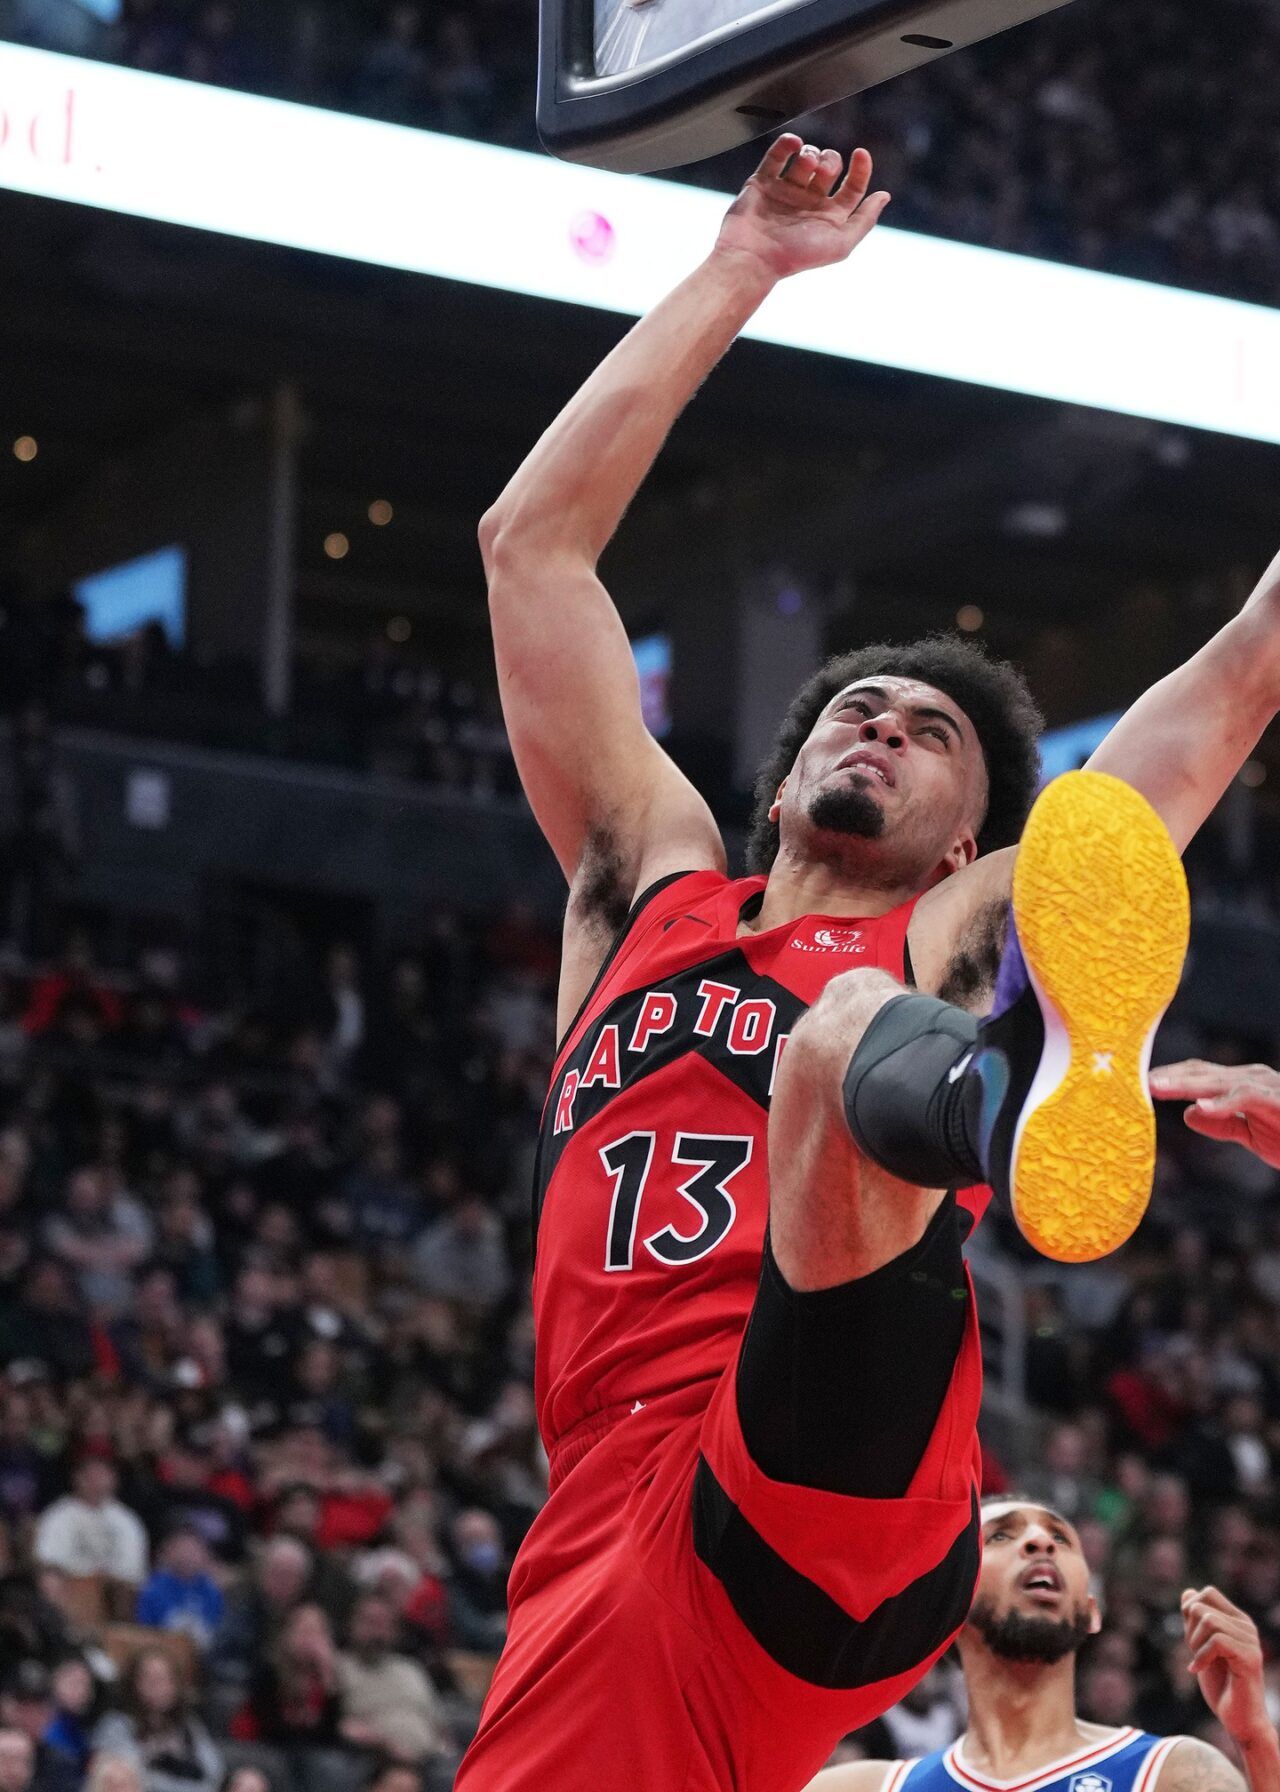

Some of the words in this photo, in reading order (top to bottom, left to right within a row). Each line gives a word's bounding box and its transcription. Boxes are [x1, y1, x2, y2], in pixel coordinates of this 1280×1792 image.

[790, 939, 827, 952] Sun
[831, 944, 866, 953] Life
[553, 979, 790, 1136] RAPTO
[597, 1131, 755, 1273] 13
